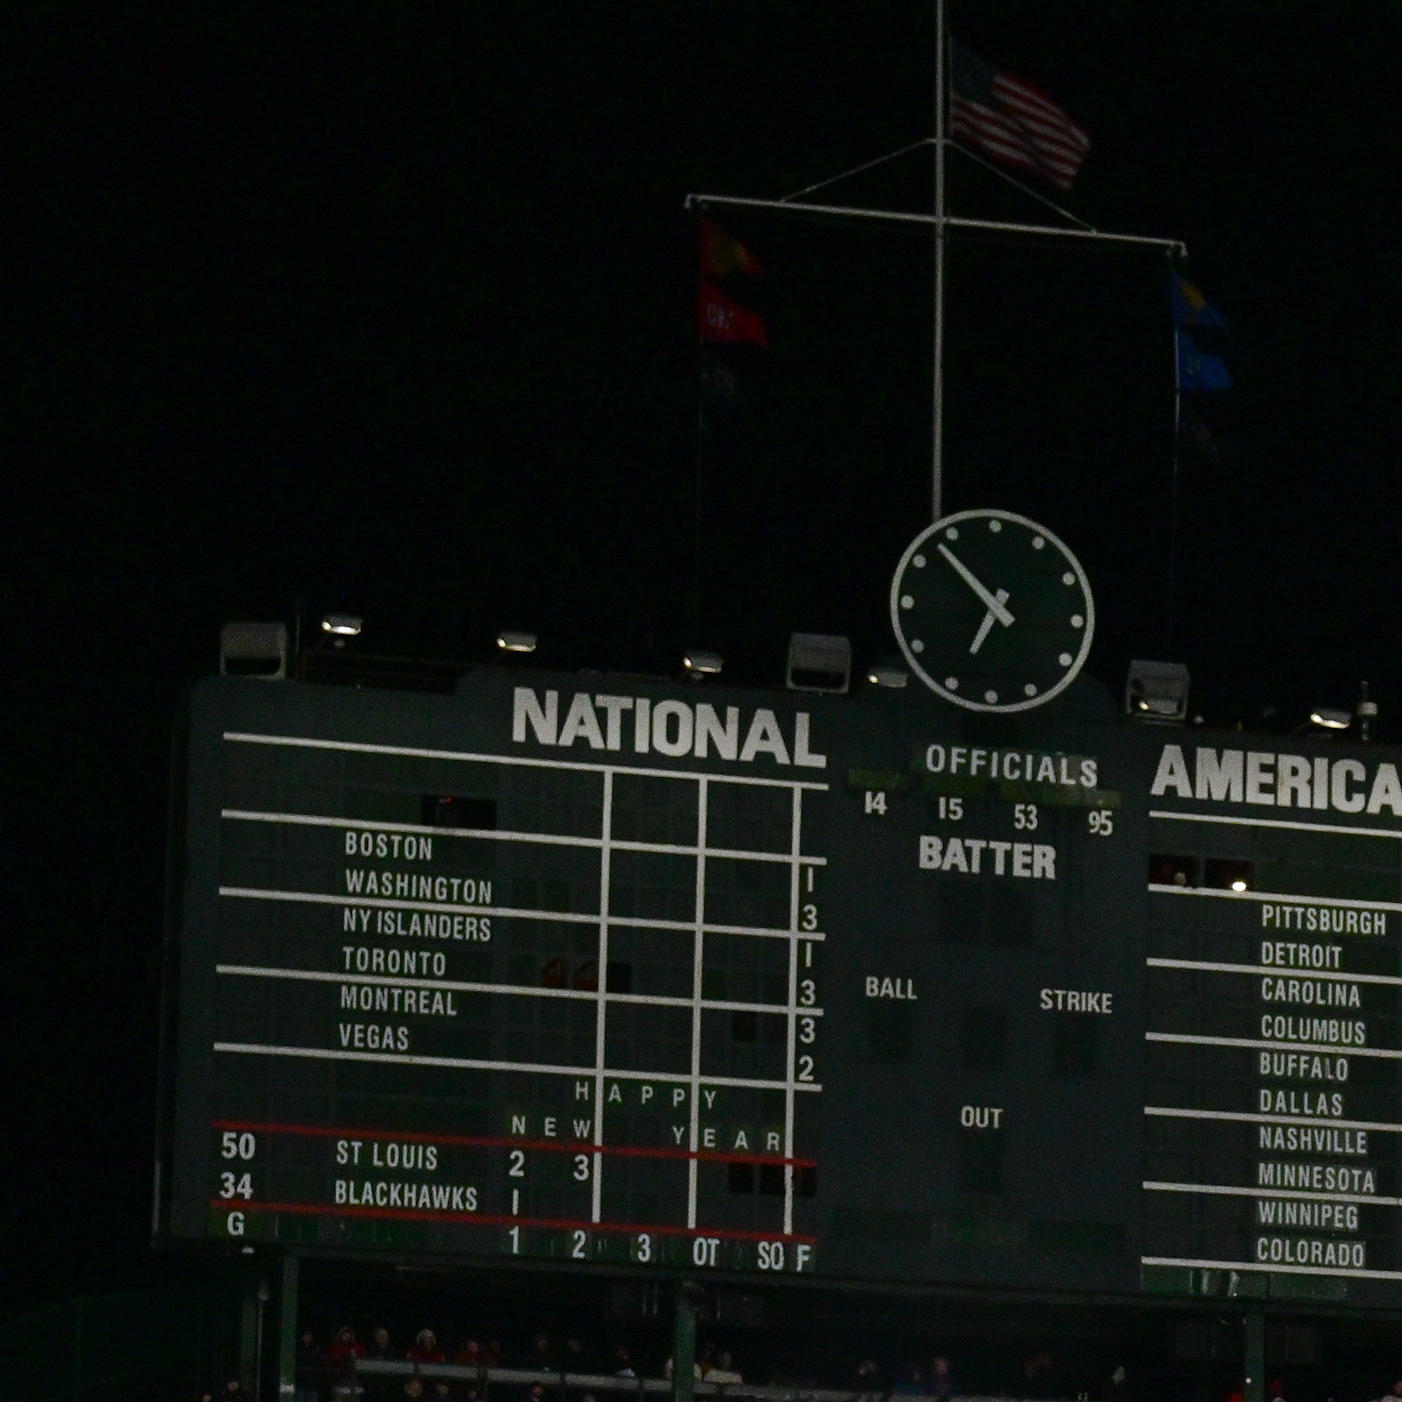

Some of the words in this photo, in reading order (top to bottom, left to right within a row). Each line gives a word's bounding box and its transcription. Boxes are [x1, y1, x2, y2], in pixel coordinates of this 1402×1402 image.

[513, 687, 827, 768] NATIONAL
[926, 744, 1098, 789] OFFICIALS
[865, 791, 887, 815] 14
[938, 797, 963, 820] 15
[1014, 803, 1038, 830] 53
[1088, 810, 1113, 836] 95
[345, 832, 433, 860] BOSTON
[919, 835, 1057, 880] BATTER
[345, 869, 493, 905] WASHINGTON
[343, 911, 371, 934] NY
[376, 912, 492, 943] ISLANDERS
[802, 905, 818, 931] 3
[1261, 904, 1387, 936] PITTSBURGH
[342, 946, 447, 977] TORONTO
[1261, 941, 1343, 970] DETROIT
[340, 984, 457, 1017] MONTREAL
[800, 979, 816, 1006] 3
[865, 976, 917, 1000] BALL
[1040, 988, 1113, 1014] STRIKE
[1261, 977, 1361, 1008] CAROLINA
[338, 1023, 409, 1053] VEGAS
[799, 1017, 815, 1044] 3
[1261, 1014, 1366, 1045] COLUMBUS
[798, 1054, 814, 1082] 2
[1259, 1052, 1349, 1082] BUFFALO
[961, 1106, 1003, 1129] OUT
[1259, 1089, 1343, 1117] DALLAS
[1259, 1126, 1368, 1155] NASHVILLE
[220, 1131, 257, 1160] 50
[336, 1141, 363, 1167] ST
[371, 1143, 438, 1172] LOUIS
[508, 1150, 526, 1177] 2
[573, 1155, 590, 1182] 3
[220, 1172, 254, 1201] 34
[334, 1179, 478, 1213] BLACKHAWKS
[1258, 1163, 1375, 1193] MINNESOTA
[226, 1211, 246, 1237] G
[1258, 1201, 1359, 1230] WINNIPEG
[508, 1226, 521, 1255] 1
[572, 1230, 587, 1260] 2
[637, 1234, 652, 1263] 3
[692, 1237, 720, 1267] OT
[756, 1241, 785, 1271] SO
[797, 1243, 812, 1272] F
[1257, 1237, 1365, 1268] COLORADO
